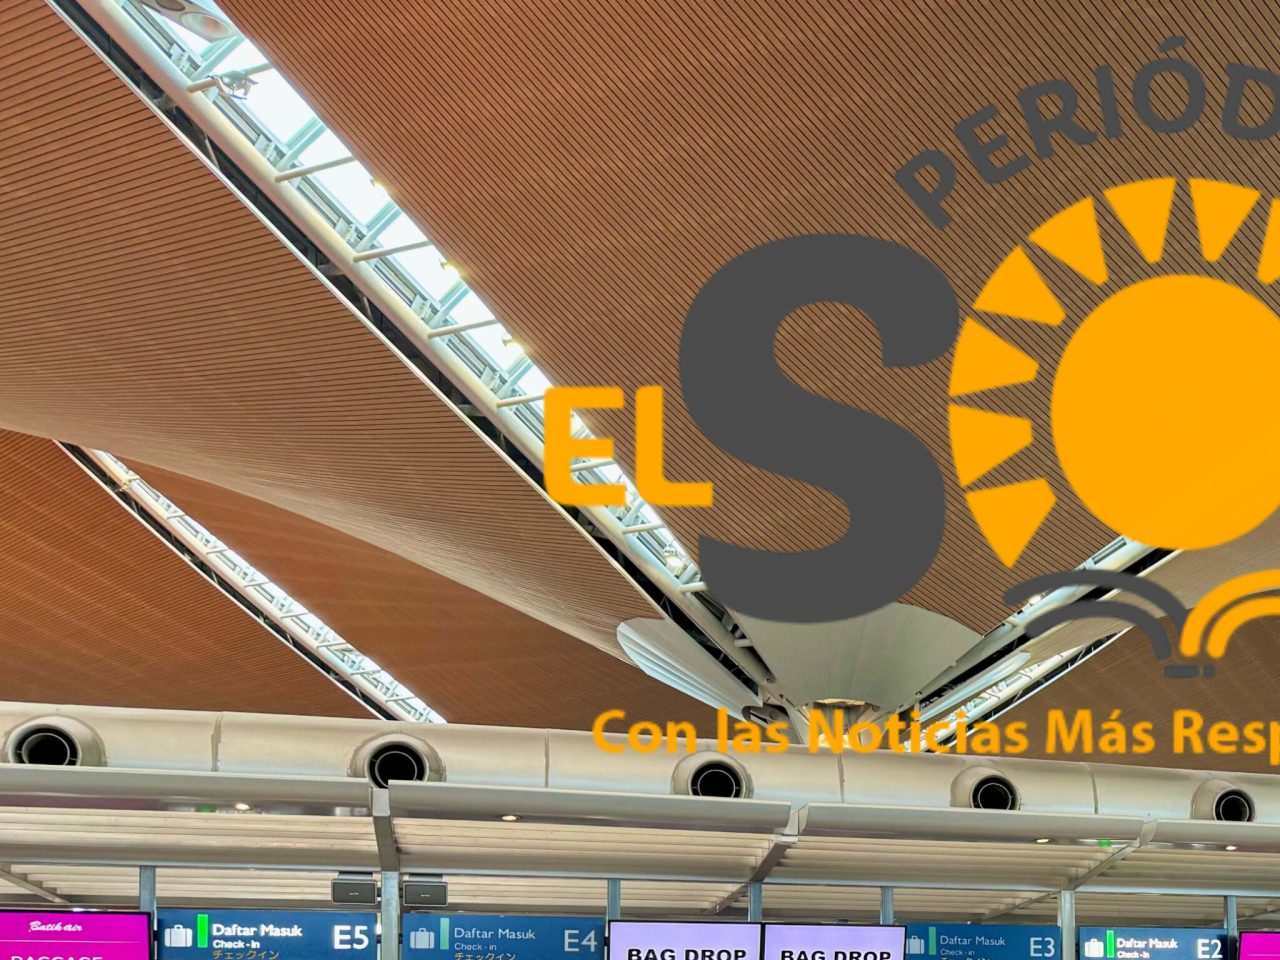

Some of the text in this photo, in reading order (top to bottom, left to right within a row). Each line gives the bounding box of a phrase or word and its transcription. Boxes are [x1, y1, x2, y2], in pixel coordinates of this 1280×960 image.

[28, 920, 82, 932] Batik air
[212, 924, 303, 937] Daftar Masuk
[333, 925, 369, 950] E5
[454, 928, 536, 940] Daftar Masuk
[564, 929, 597, 952] E4
[940, 935, 1006, 946] Daftar Masuk
[1116, 937, 1178, 949] Daftar Masuk
[1030, 937, 1055, 957] E3
[1196, 938, 1223, 959] E2
[211, 951, 280, 960] チェックイン
